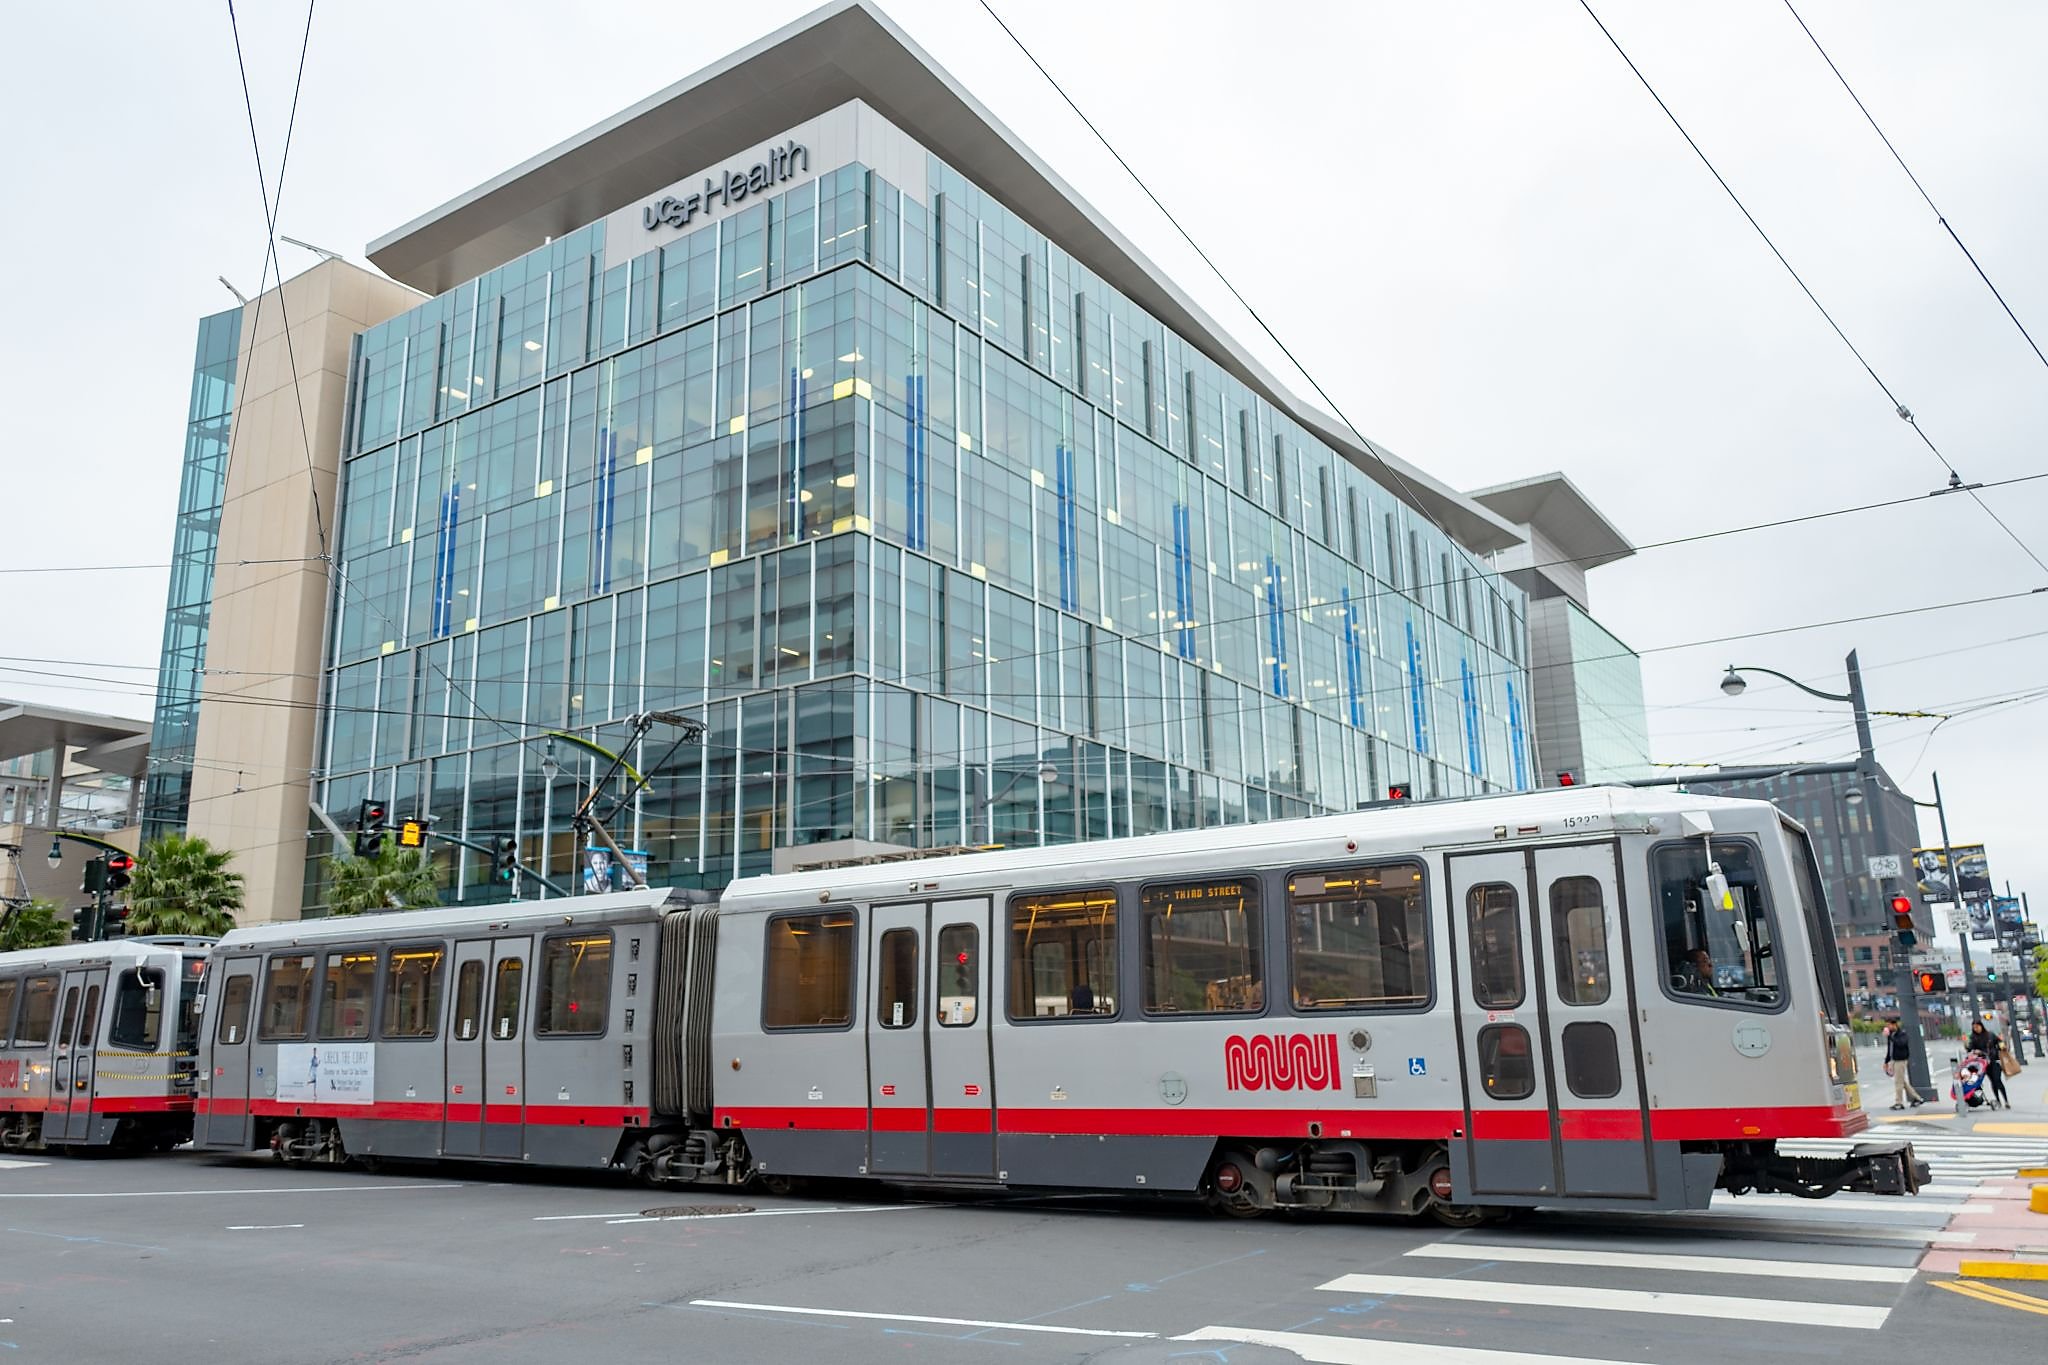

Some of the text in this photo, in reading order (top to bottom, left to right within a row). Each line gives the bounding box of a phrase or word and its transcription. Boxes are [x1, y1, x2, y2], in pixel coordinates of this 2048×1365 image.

[643, 139, 808, 231] UCSF Health
[1174, 888, 1203, 900] THIRD
[1207, 885, 1243, 897] STREET
[1952, 920, 1970, 931] 25
[1224, 1033, 1342, 1091] MUNI
